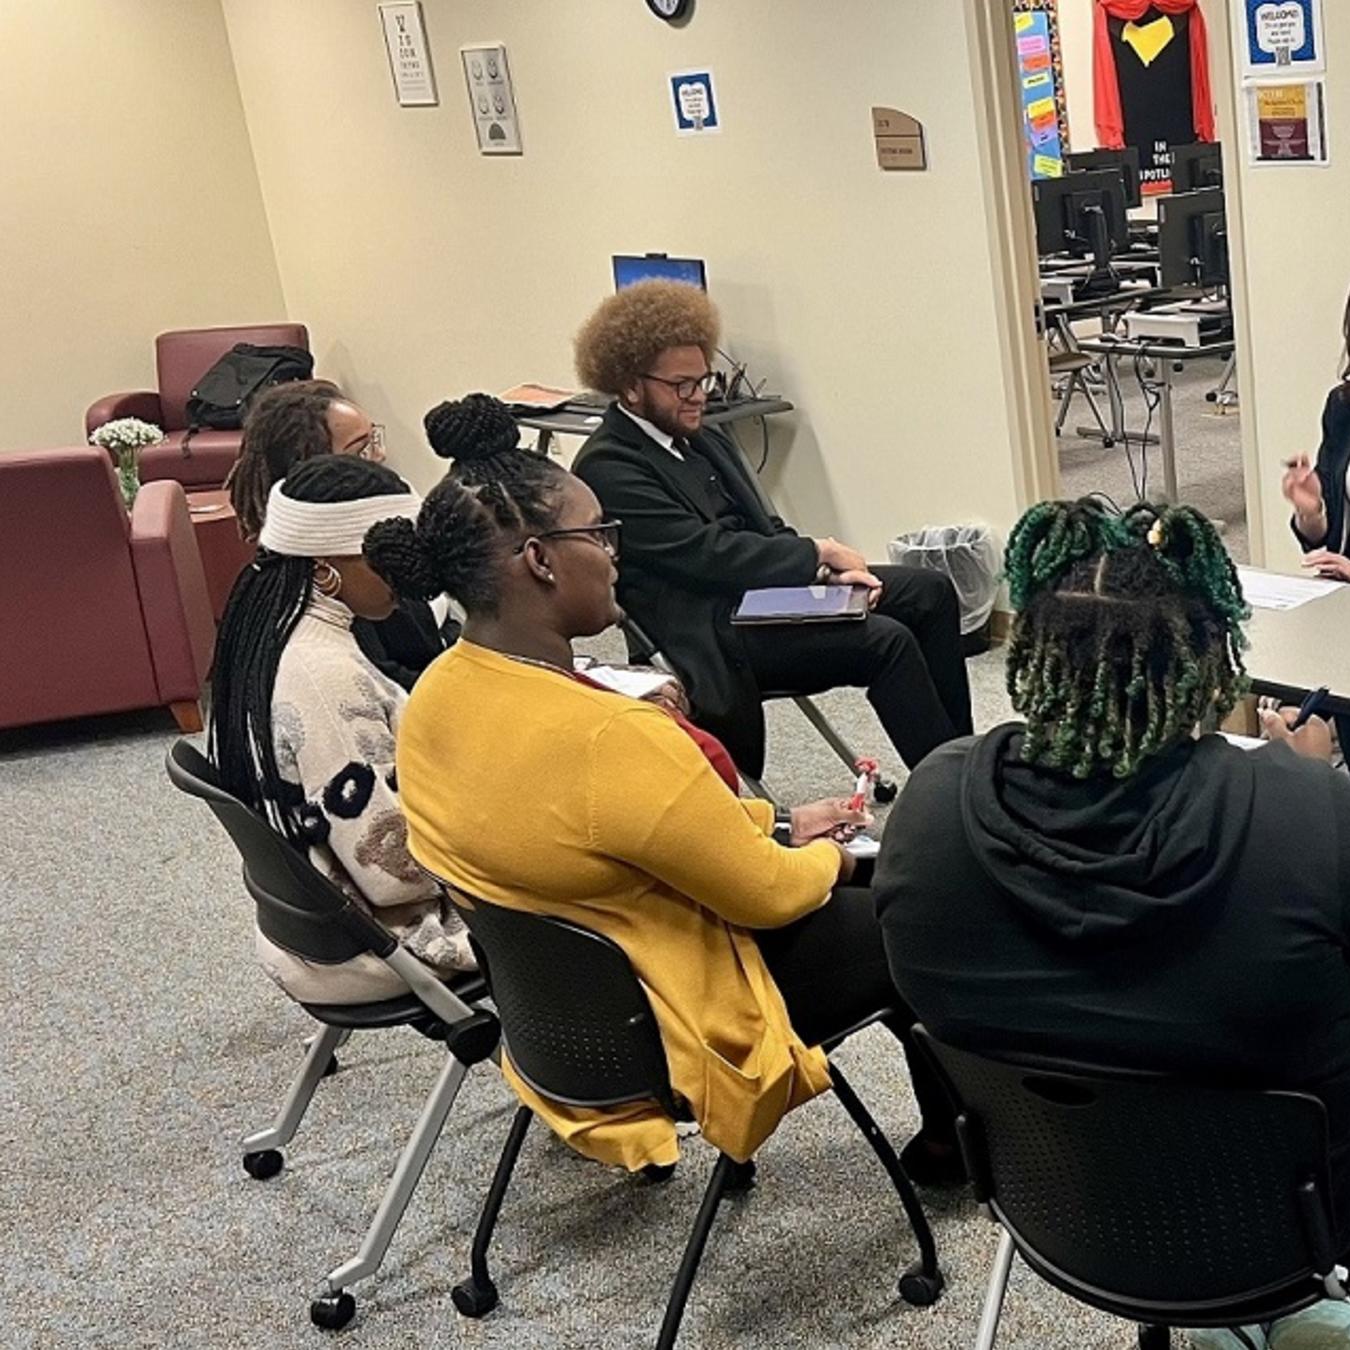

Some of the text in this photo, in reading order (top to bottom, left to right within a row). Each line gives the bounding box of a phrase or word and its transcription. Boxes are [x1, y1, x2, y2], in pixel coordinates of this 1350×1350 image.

[1154, 140, 1167, 152] IN
[1152, 153, 1170, 165] THE
[1139, 168, 1171, 180] POTLI
